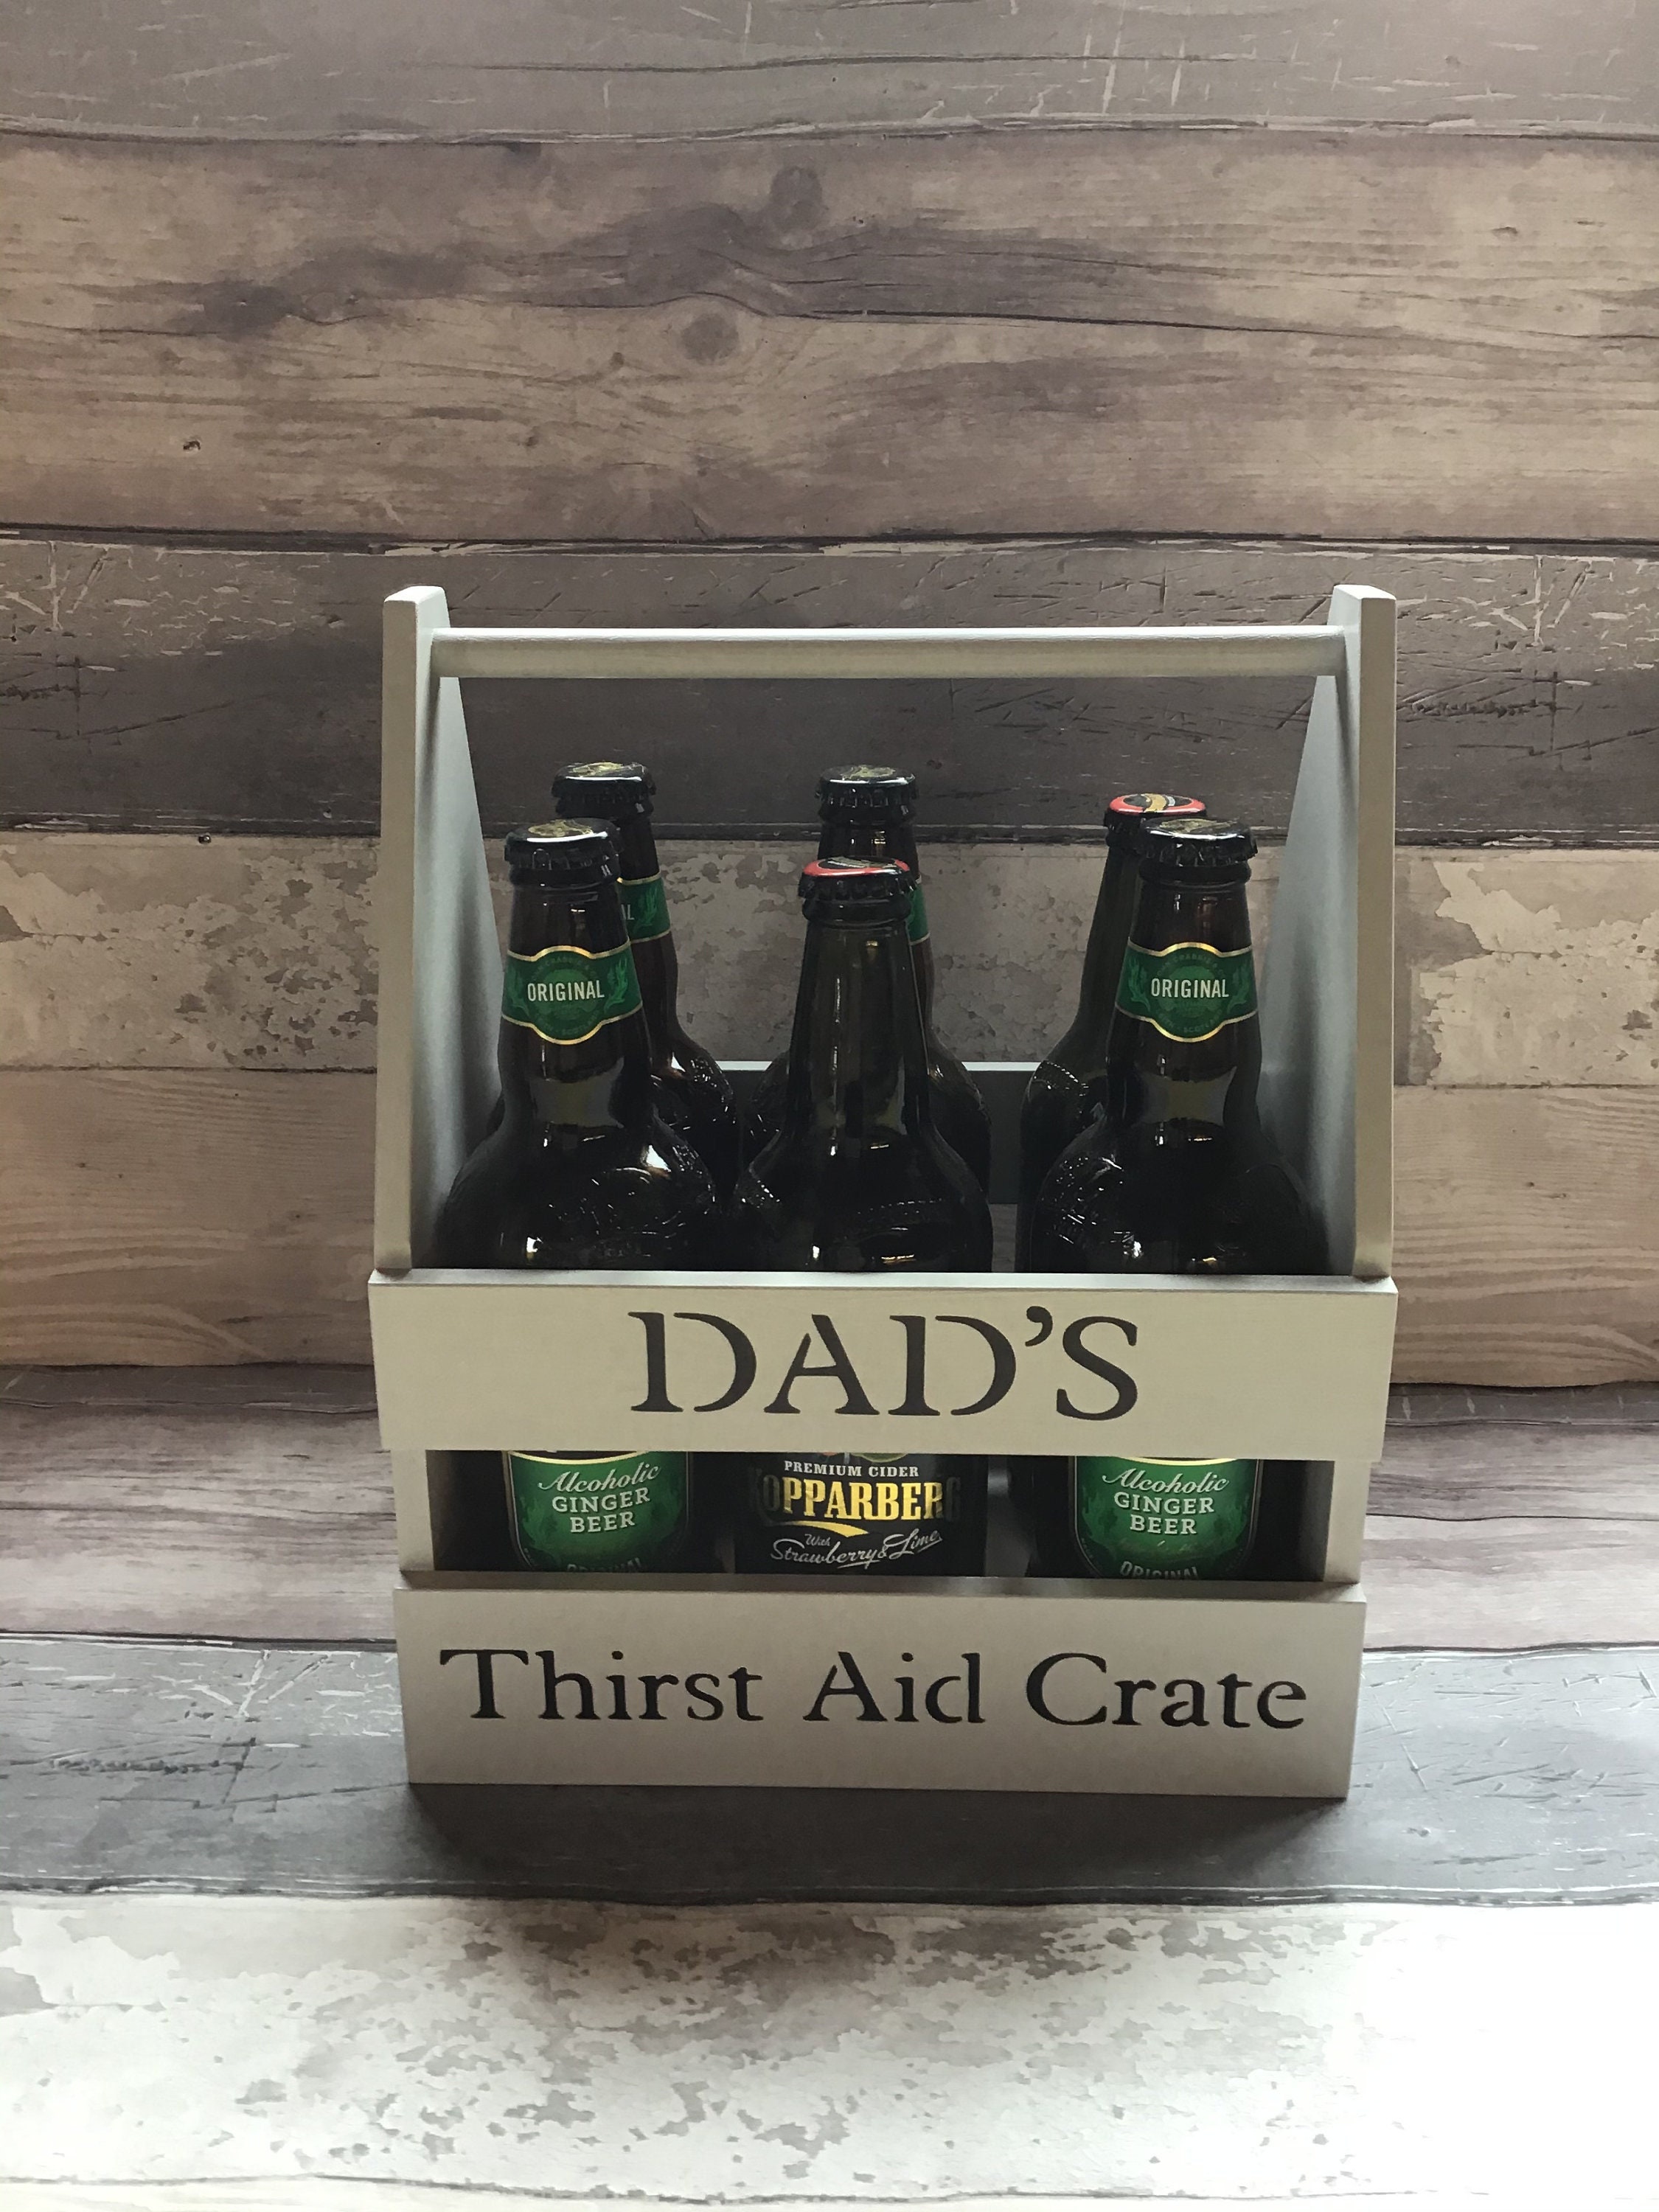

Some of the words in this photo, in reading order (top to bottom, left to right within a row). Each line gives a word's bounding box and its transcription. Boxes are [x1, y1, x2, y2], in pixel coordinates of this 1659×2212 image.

[527, 979, 605, 1002] ORIGINAL
[1150, 977, 1230, 999] ORIGINAL
[538, 1461, 661, 1493] Alcoholic
[785, 1461, 862, 1477] PREMIUM
[869, 1466, 919, 1478] CIDER
[1102, 1468, 1230, 1494] Alcoholic
[552, 1486, 650, 1513] GINGER
[748, 1470, 961, 1522] OPPARBERG
[1114, 1492, 1216, 1515] GINGER
[570, 1512, 636, 1534] BEER
[1130, 1514, 1197, 1535] BEER
[804, 1534, 831, 1547] With
[439, 1649, 762, 1722] Thirst
[802, 1650, 986, 1725] Aid
[1027, 1652, 1307, 1729] Crate
